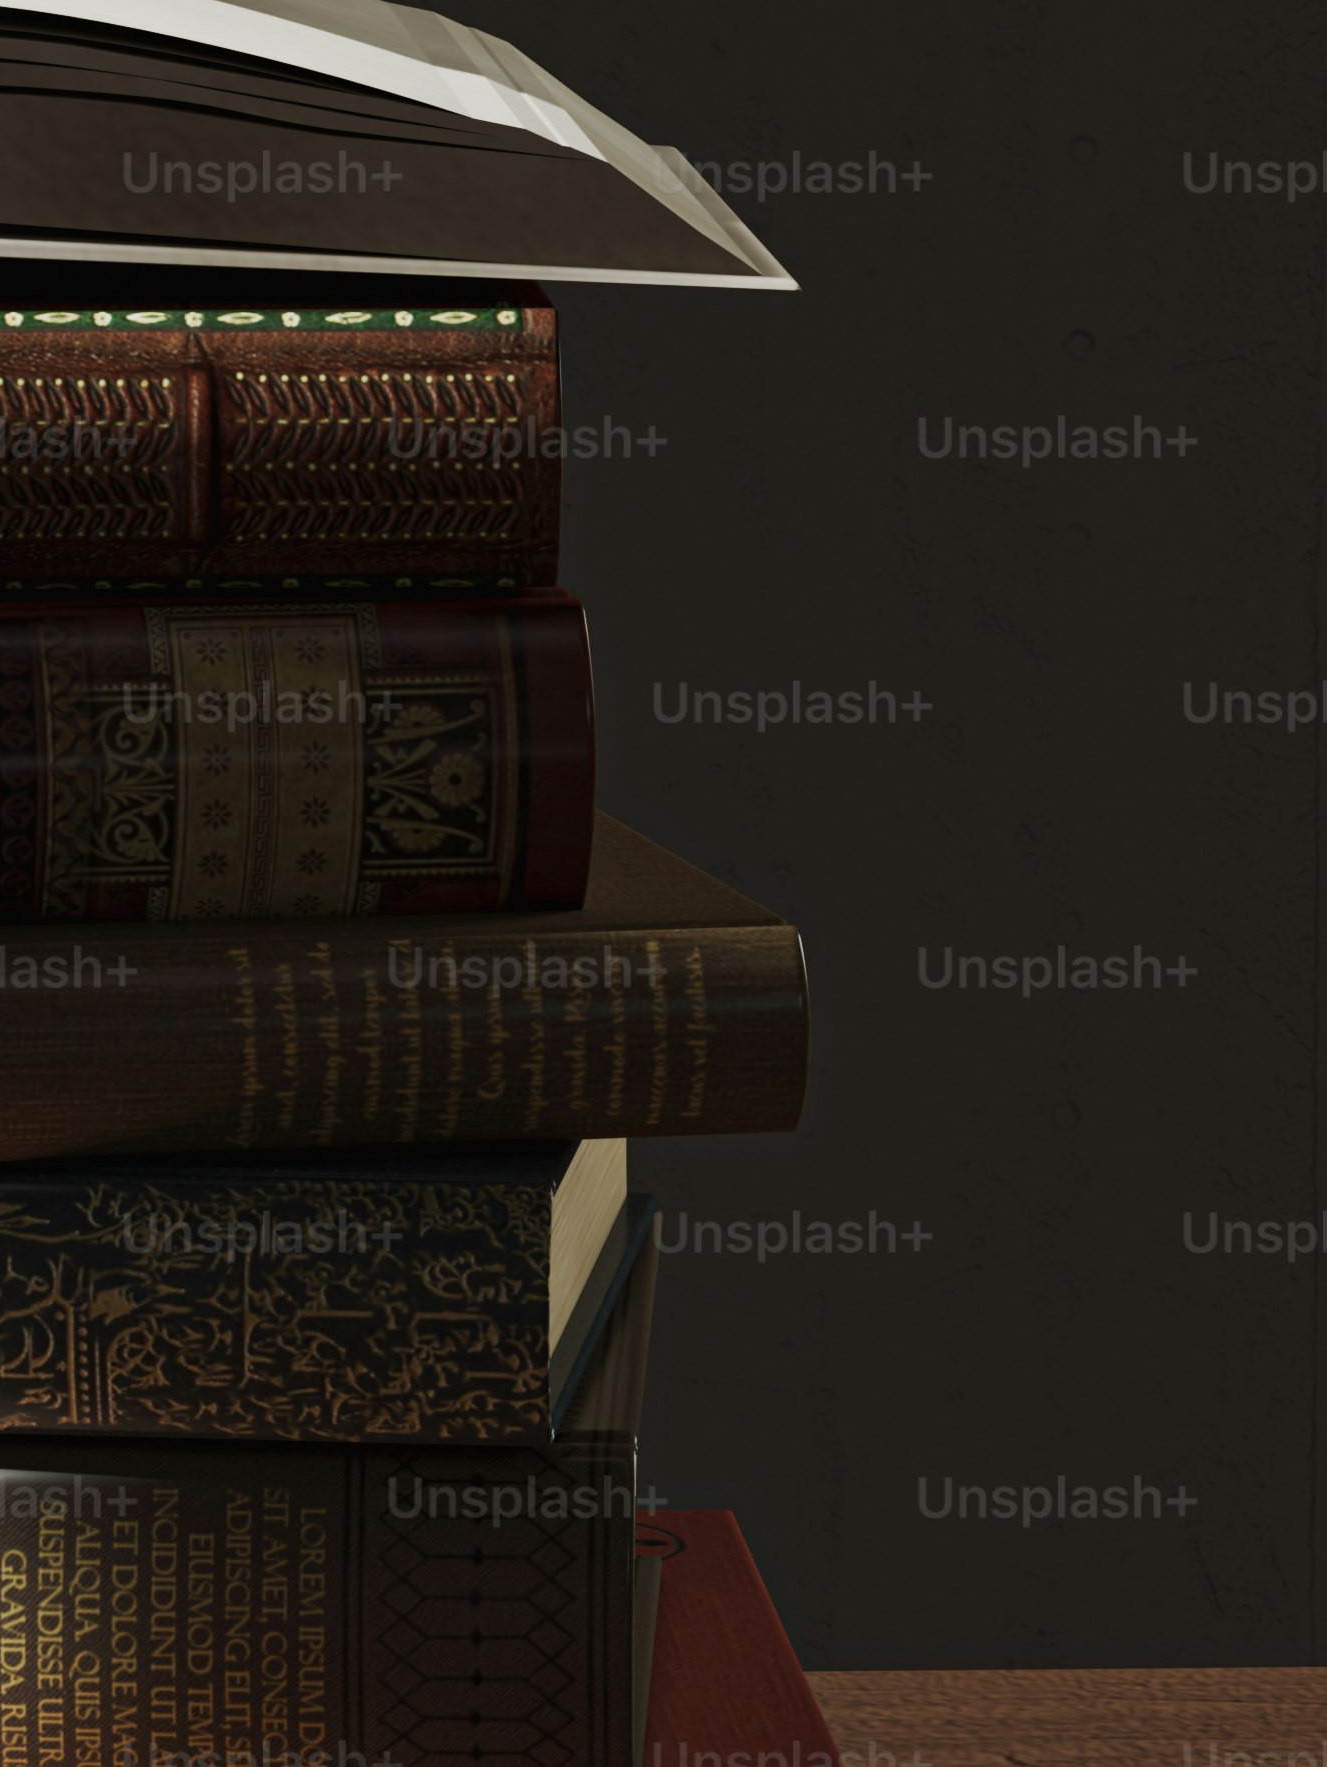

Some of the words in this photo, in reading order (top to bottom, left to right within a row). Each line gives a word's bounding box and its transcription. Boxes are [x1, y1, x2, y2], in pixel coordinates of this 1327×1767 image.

[227, 947, 251, 971] sit
[309, 969, 334, 999] sed
[231, 976, 257, 1029] dolor
[241, 1037, 265, 1095] ipsum
[401, 1028, 421, 1048] ut
[687, 1040, 707, 1064] vel
[476, 1052, 507, 1100] Quis
[681, 1073, 706, 1116] lacus
[262, 1488, 288, 1526] SIT
[112, 1520, 138, 1555] ET
[298, 1507, 326, 1616] LOREM
[37, 1500, 64, 1690] SUSPENDISSE
[68, 1519, 101, 1642] ALIQUA.
[151, 1488, 178, 1676] INCIDIDUNT
[225, 1488, 252, 1661] ADIPISCING
[256, 1535, 288, 1623] AMET,
[0, 1549, 27, 1694] GRAVIDA.
[111, 1565, 137, 1696] DOLORE
[187, 1533, 215, 1675] EIUSMOD
[68, 1651, 100, 1720] QUIS
[297, 1626, 325, 1713] IPSUM
[151, 1686, 176, 1724] UT
[220, 1671, 251, 1730] ELIT,
[150, 1732, 176, 1767] LA
